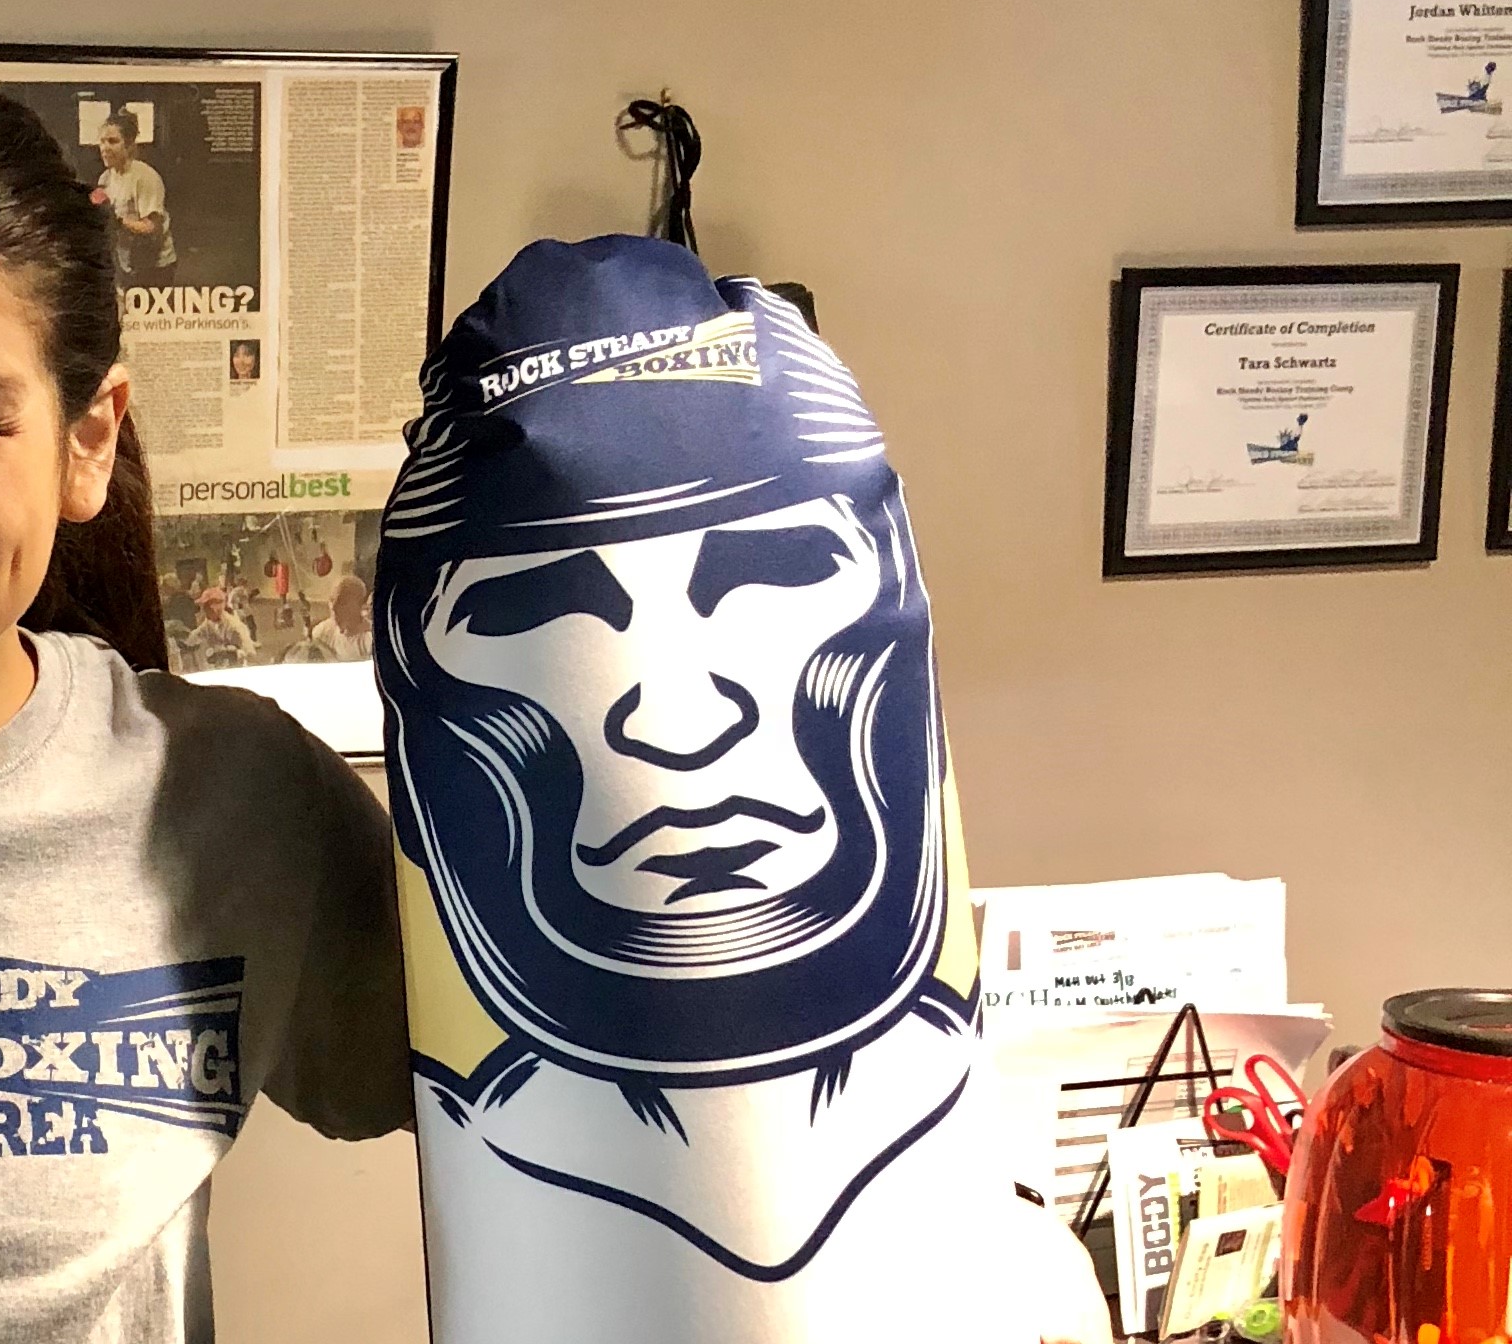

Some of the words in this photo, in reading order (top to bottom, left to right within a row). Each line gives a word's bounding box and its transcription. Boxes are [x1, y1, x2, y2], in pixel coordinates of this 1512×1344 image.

[1409, 5, 1455, 21] Jordan
[116, 286, 255, 316] OXING?
[144, 319, 172, 331] with
[1204, 323, 1277, 337] Certificate
[1280, 322, 1293, 335] of
[1297, 321, 1376, 337] Completion
[567, 325, 693, 371] STEADY
[1239, 357, 1270, 370] Tara
[1273, 356, 1337, 369] Schwartz
[1138, 1173, 1174, 1277] BODY
